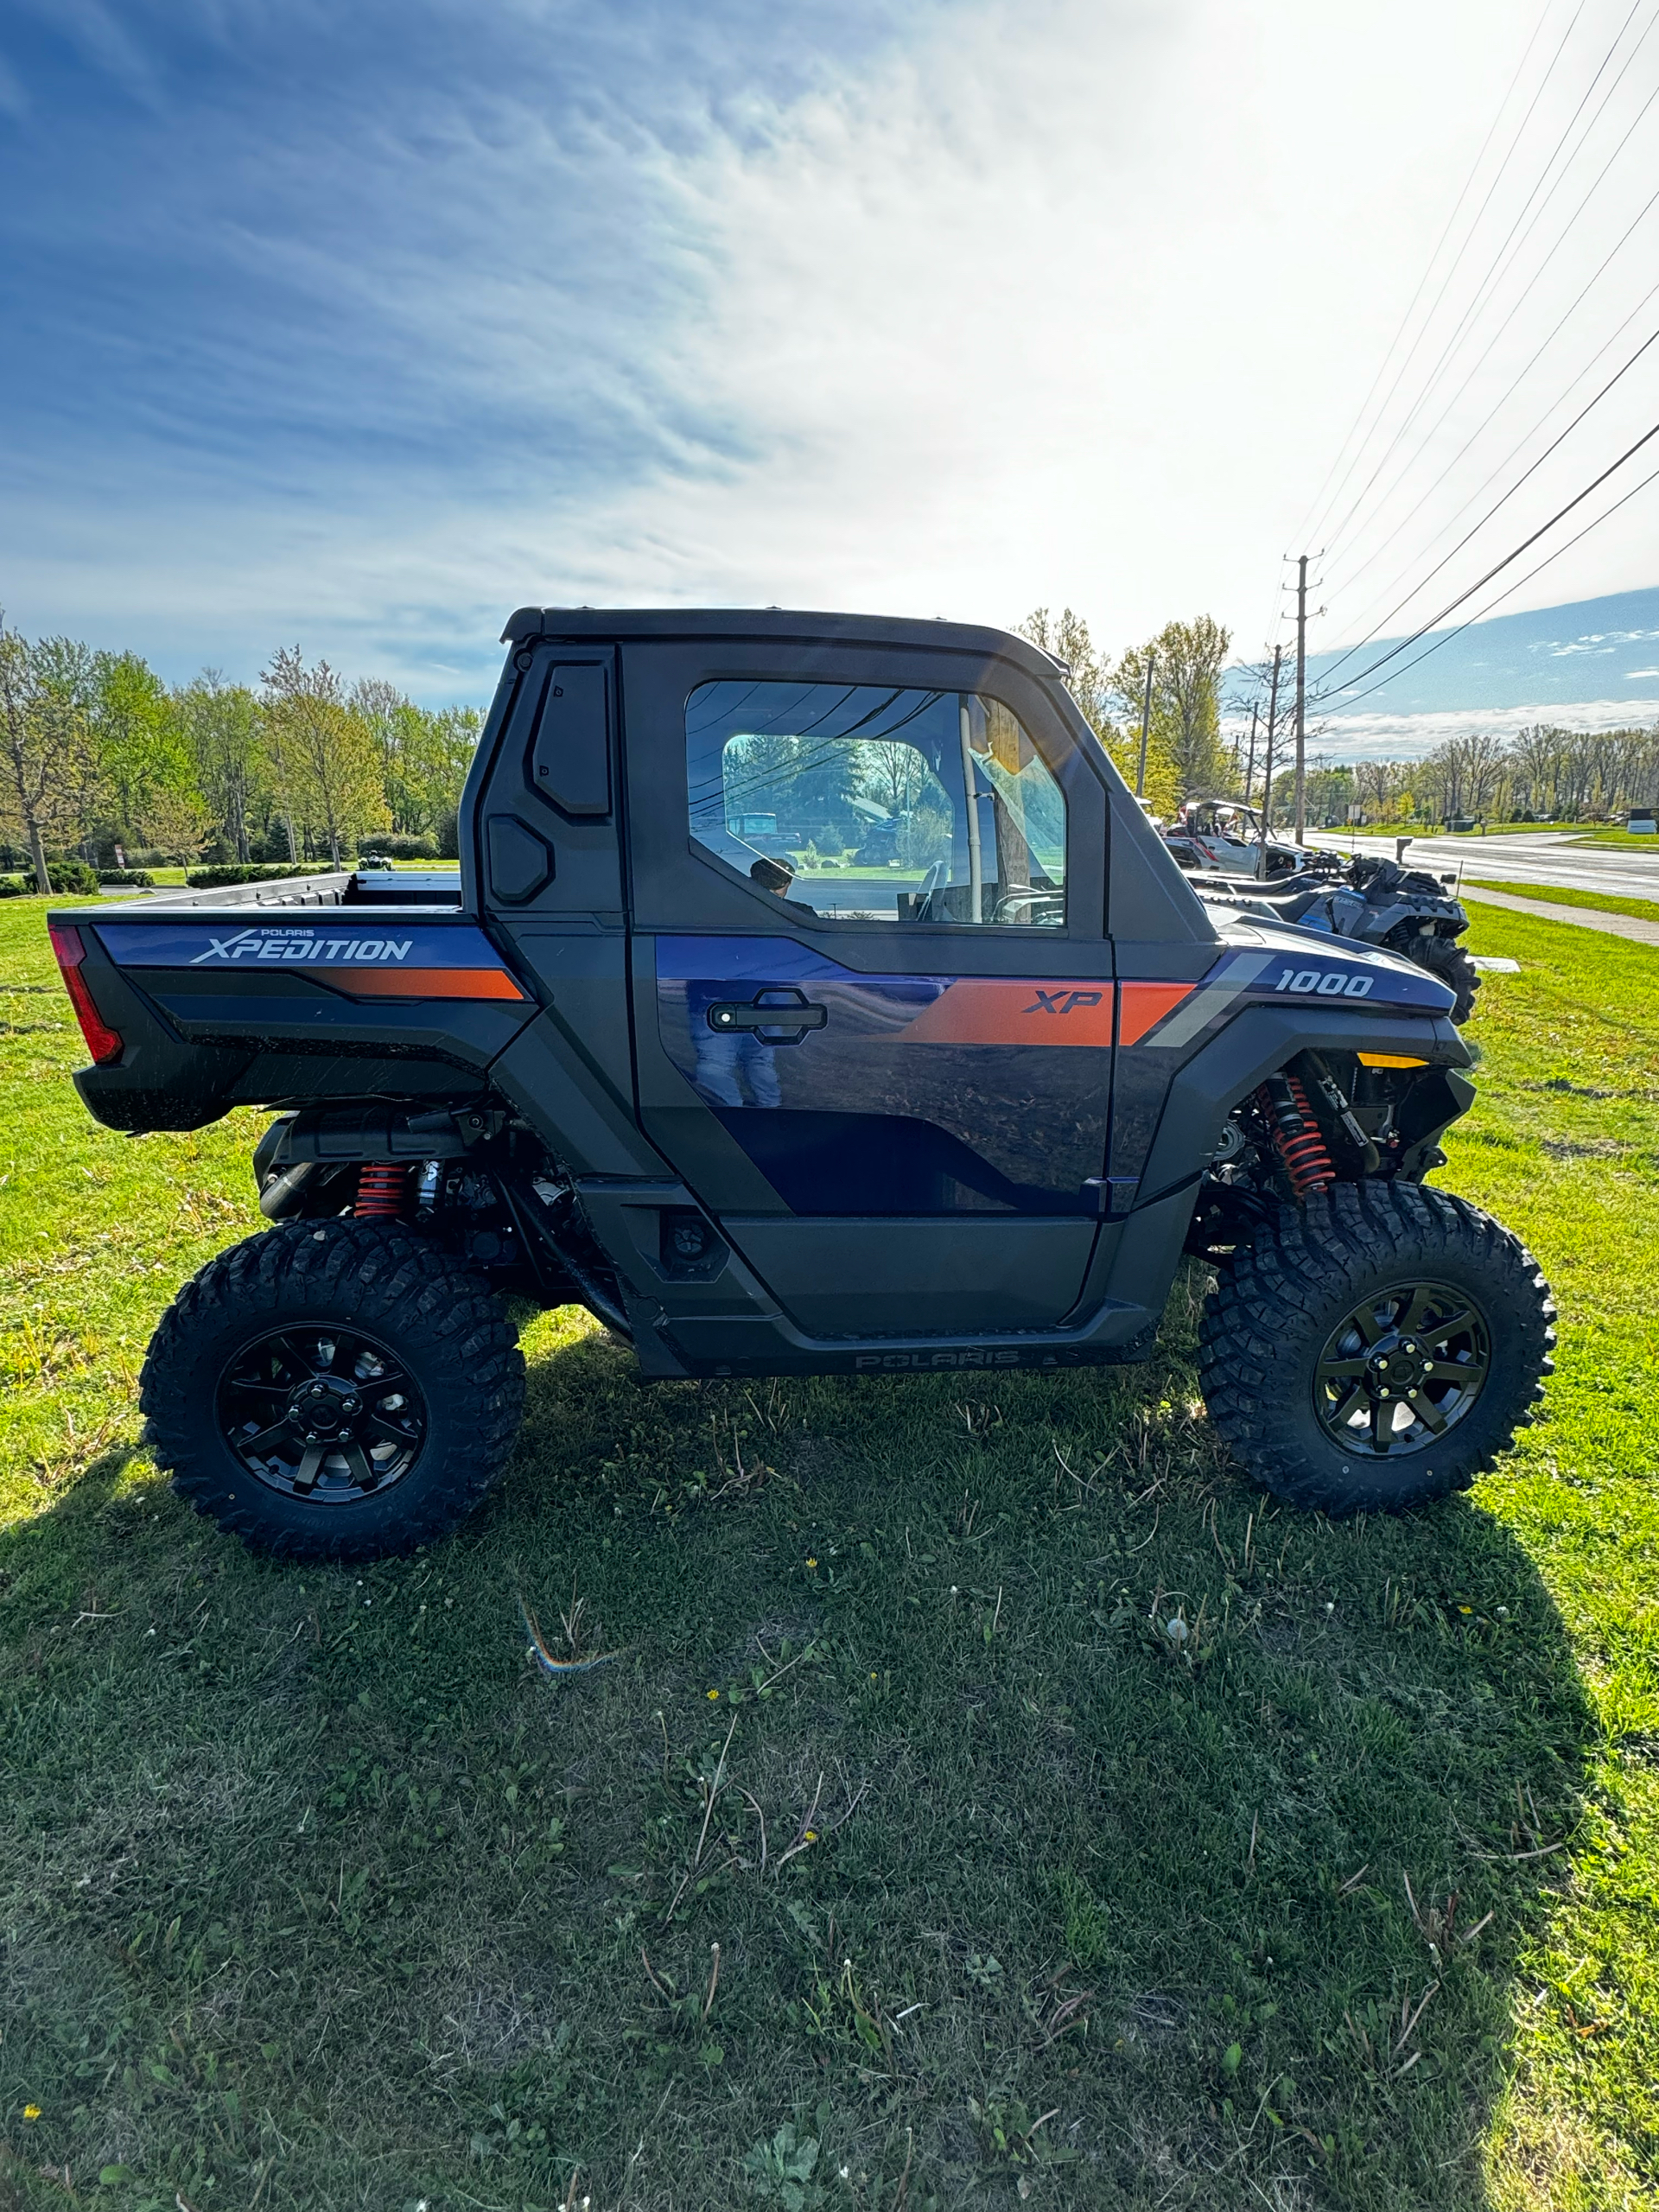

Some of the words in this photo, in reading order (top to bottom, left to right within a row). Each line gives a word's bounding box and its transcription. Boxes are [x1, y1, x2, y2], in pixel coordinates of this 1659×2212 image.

[261, 929, 315, 938] POLARIS
[188, 929, 413, 963] XPEDITION
[1274, 969, 1375, 997] 1000
[1021, 990, 1103, 1014] XP
[855, 1350, 1020, 1369] POLARIS
